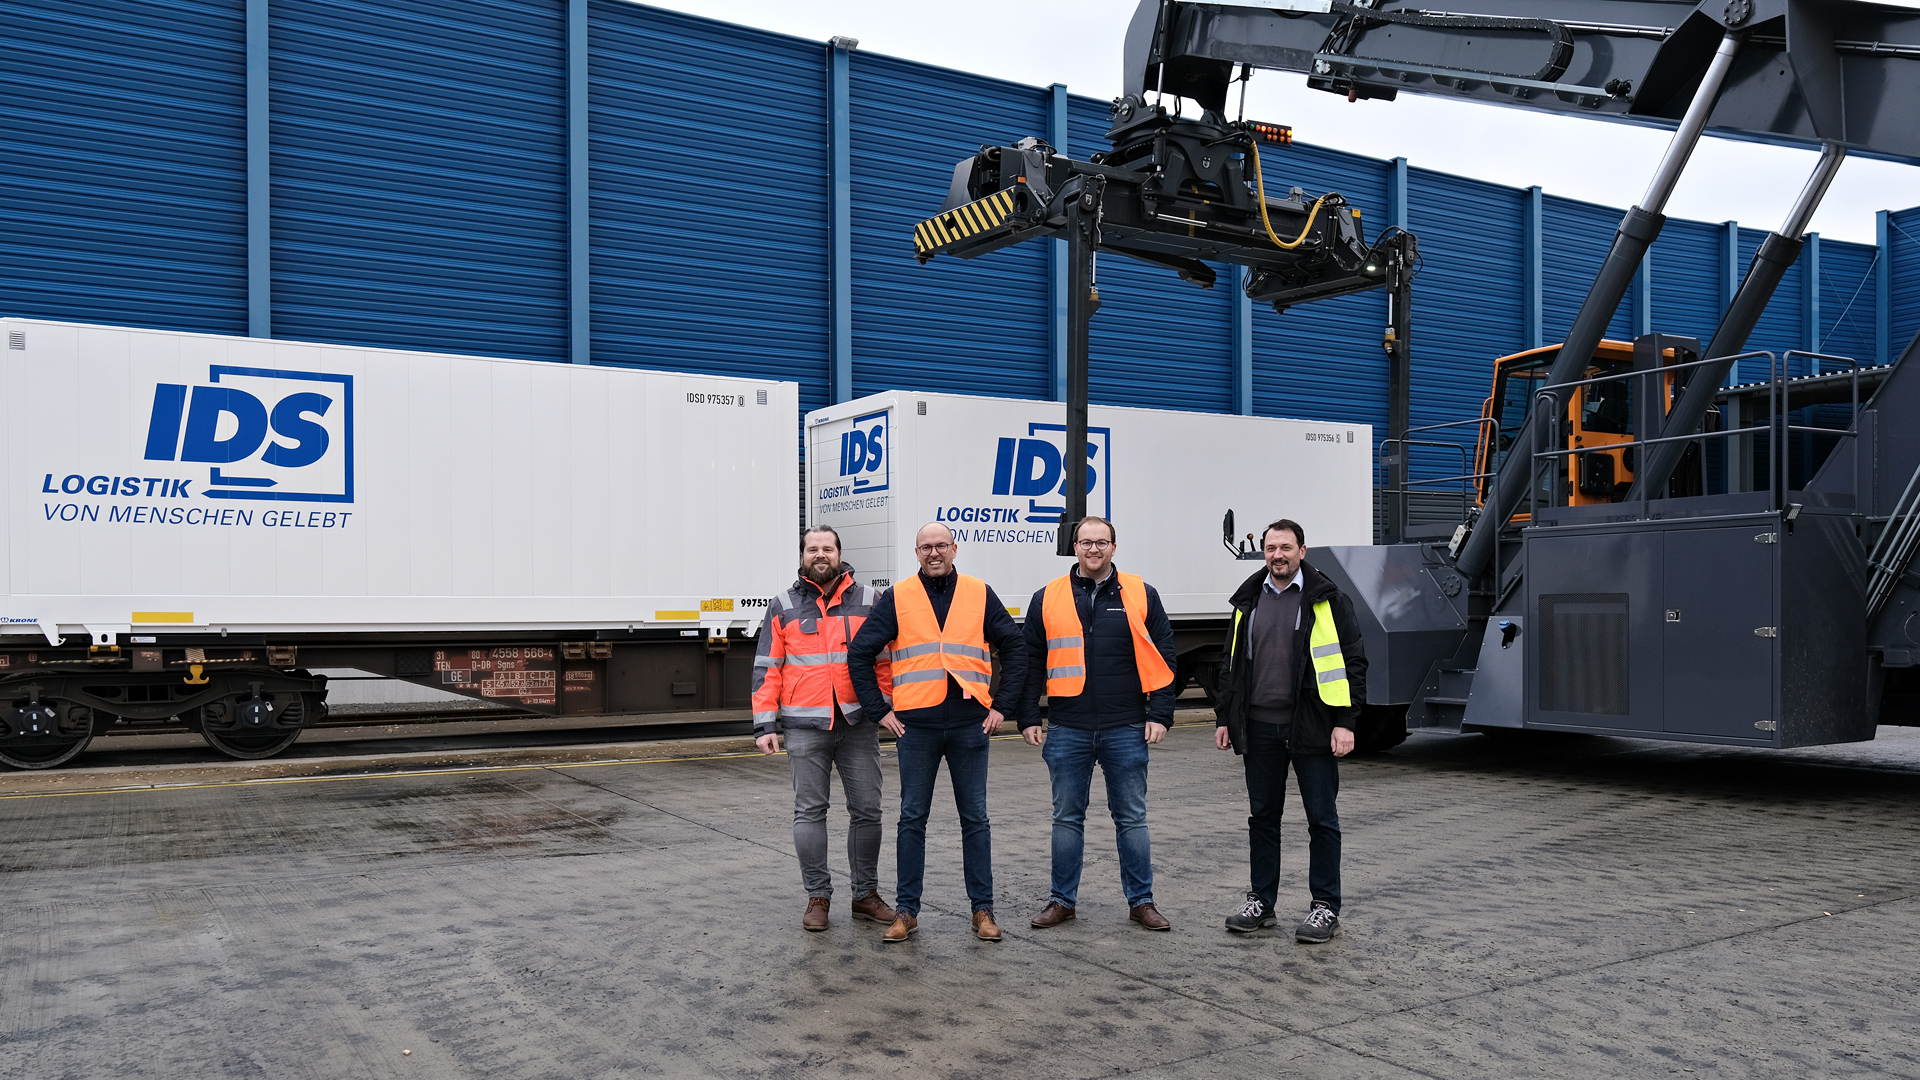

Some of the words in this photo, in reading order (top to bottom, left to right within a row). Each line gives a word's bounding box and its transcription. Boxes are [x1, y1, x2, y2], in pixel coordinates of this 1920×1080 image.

[686, 392, 705, 404] IDSD
[707, 393, 735, 406] 975357
[144, 383, 333, 467] IDS
[1317, 433, 1334, 442] 975356
[839, 425, 883, 477] IDS
[42, 473, 193, 498] LOGISTIK
[819, 485, 851, 500] LOGISTIK
[819, 503, 831, 514] VON
[832, 499, 864, 513] MENSCHEN
[865, 495, 889, 509] GELEBT
[43, 503, 101, 522] VON
[109, 505, 254, 526] MENSCHEN
[262, 510, 353, 529] GELEBT
[936, 506, 1020, 523] LOGISTIK
[950, 529, 968, 542] ON
[973, 529, 1055, 543] MENSCHEN
[871, 578, 890, 587] 9975356
[436, 651, 445, 660] 31
[471, 650, 480, 660] 80
[492, 648, 519, 658] 4558
[524, 647, 553, 658] 566-4
[436, 661, 451, 670] TEN
[471, 660, 491, 671] D-DB
[497, 661, 515, 671] Sgns
[450, 671, 463, 682] GE
